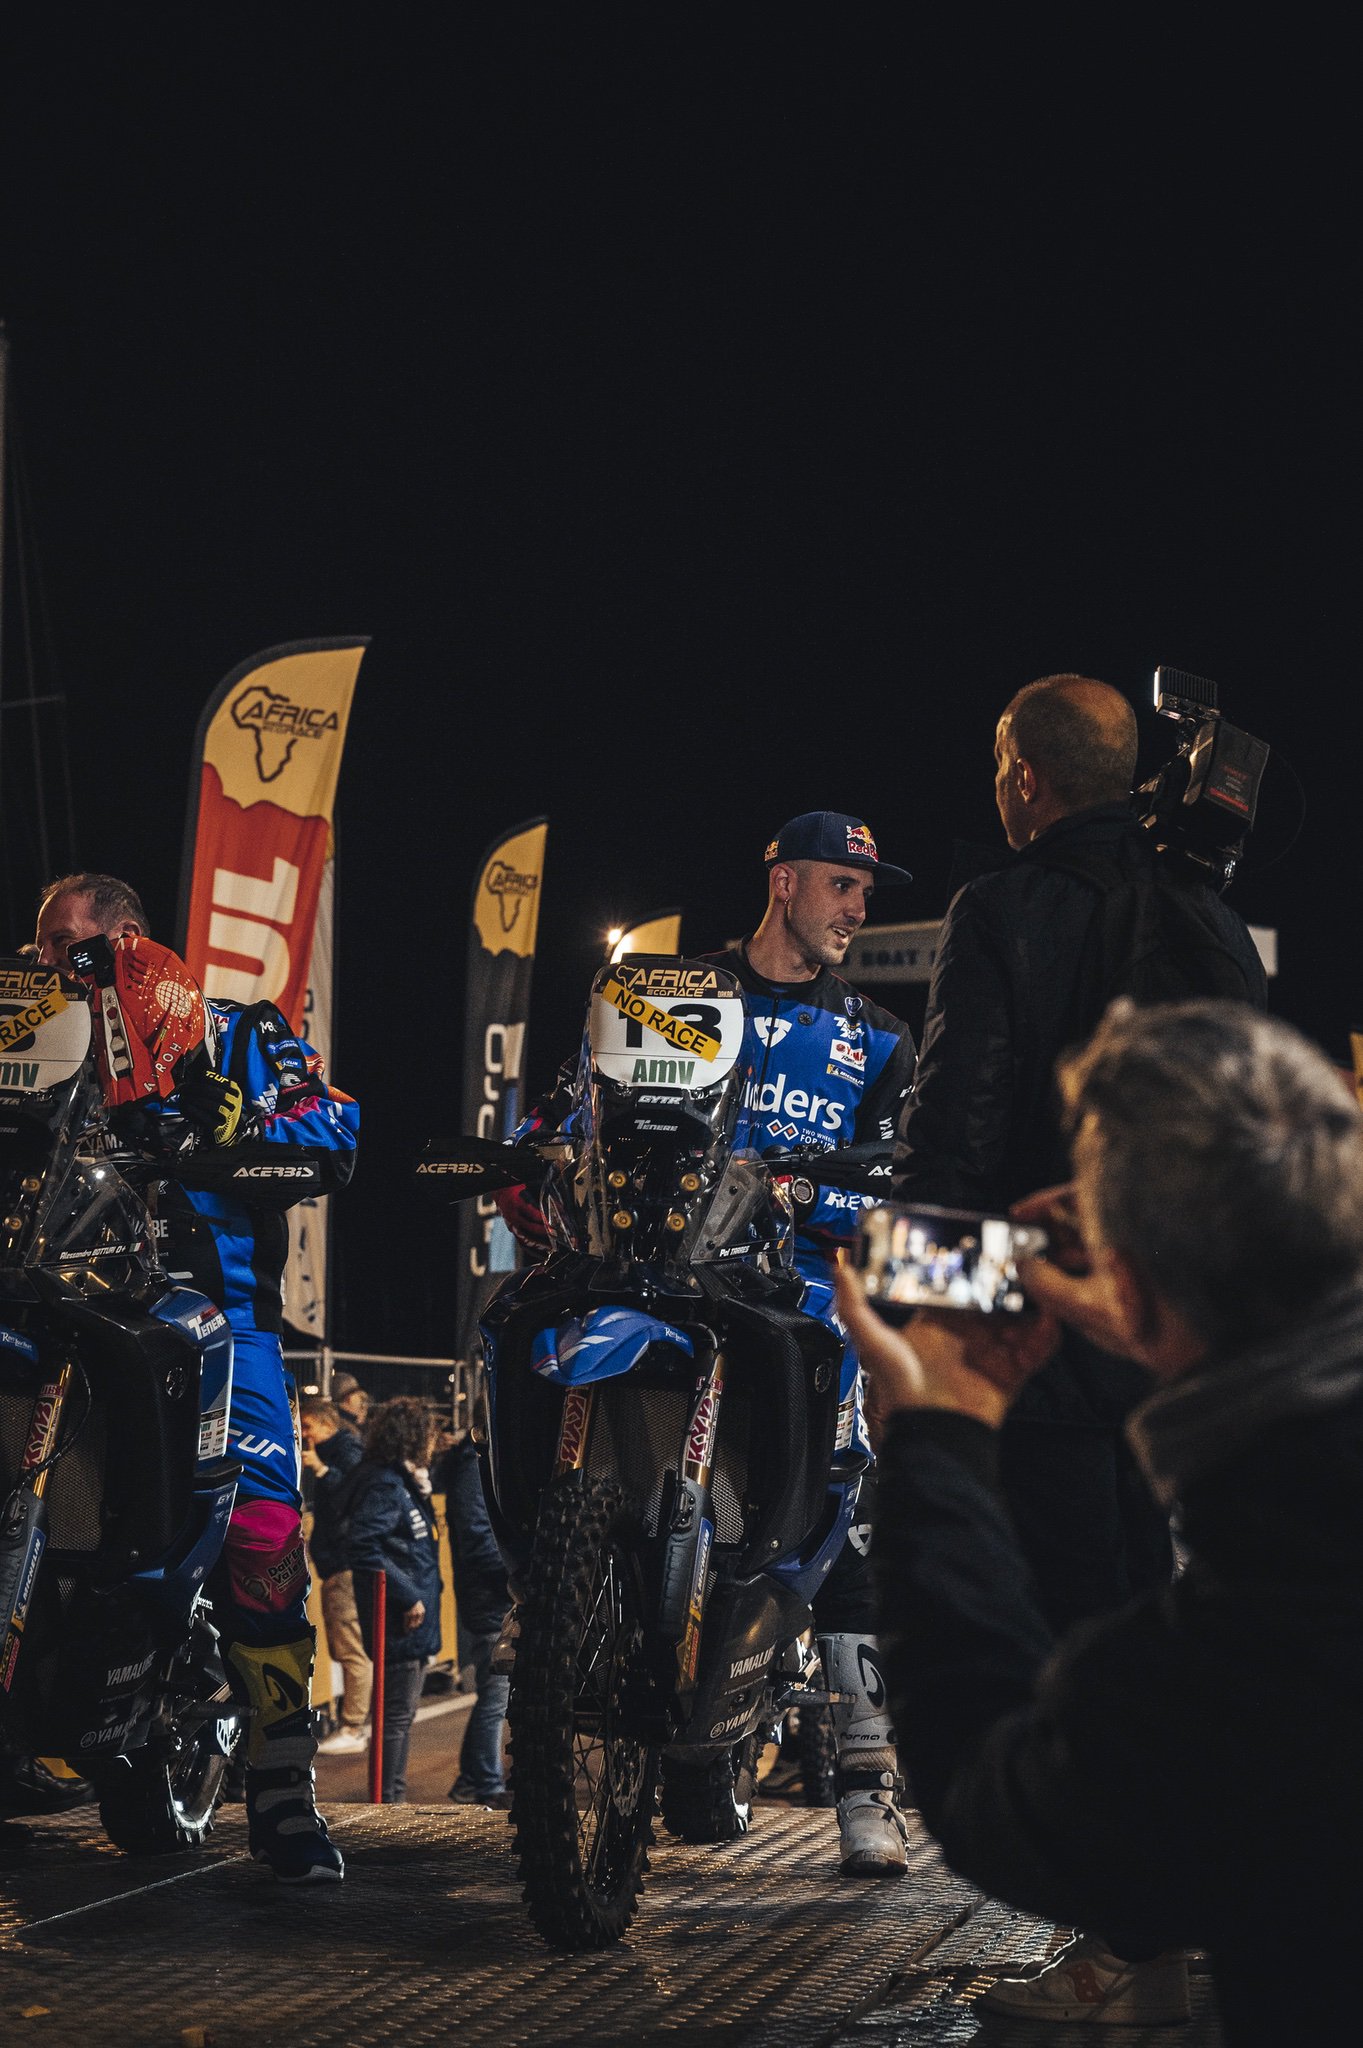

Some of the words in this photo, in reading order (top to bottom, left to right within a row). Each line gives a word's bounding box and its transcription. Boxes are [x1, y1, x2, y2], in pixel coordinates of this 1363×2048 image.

[241, 701, 339, 731] AFRICA
[627, 967, 718, 990] AFRICA
[0, 999, 57, 1046] RACE
[613, 989, 646, 1017] NO
[647, 1010, 709, 1055] RACE
[637, 1094, 684, 1105] GYTR
[801, 1127, 816, 1138] TWO
[232, 1166, 315, 1178] ACERBIS
[416, 1162, 485, 1174] ACERBIS
[23, 1537, 42, 1600] MICHELIN
